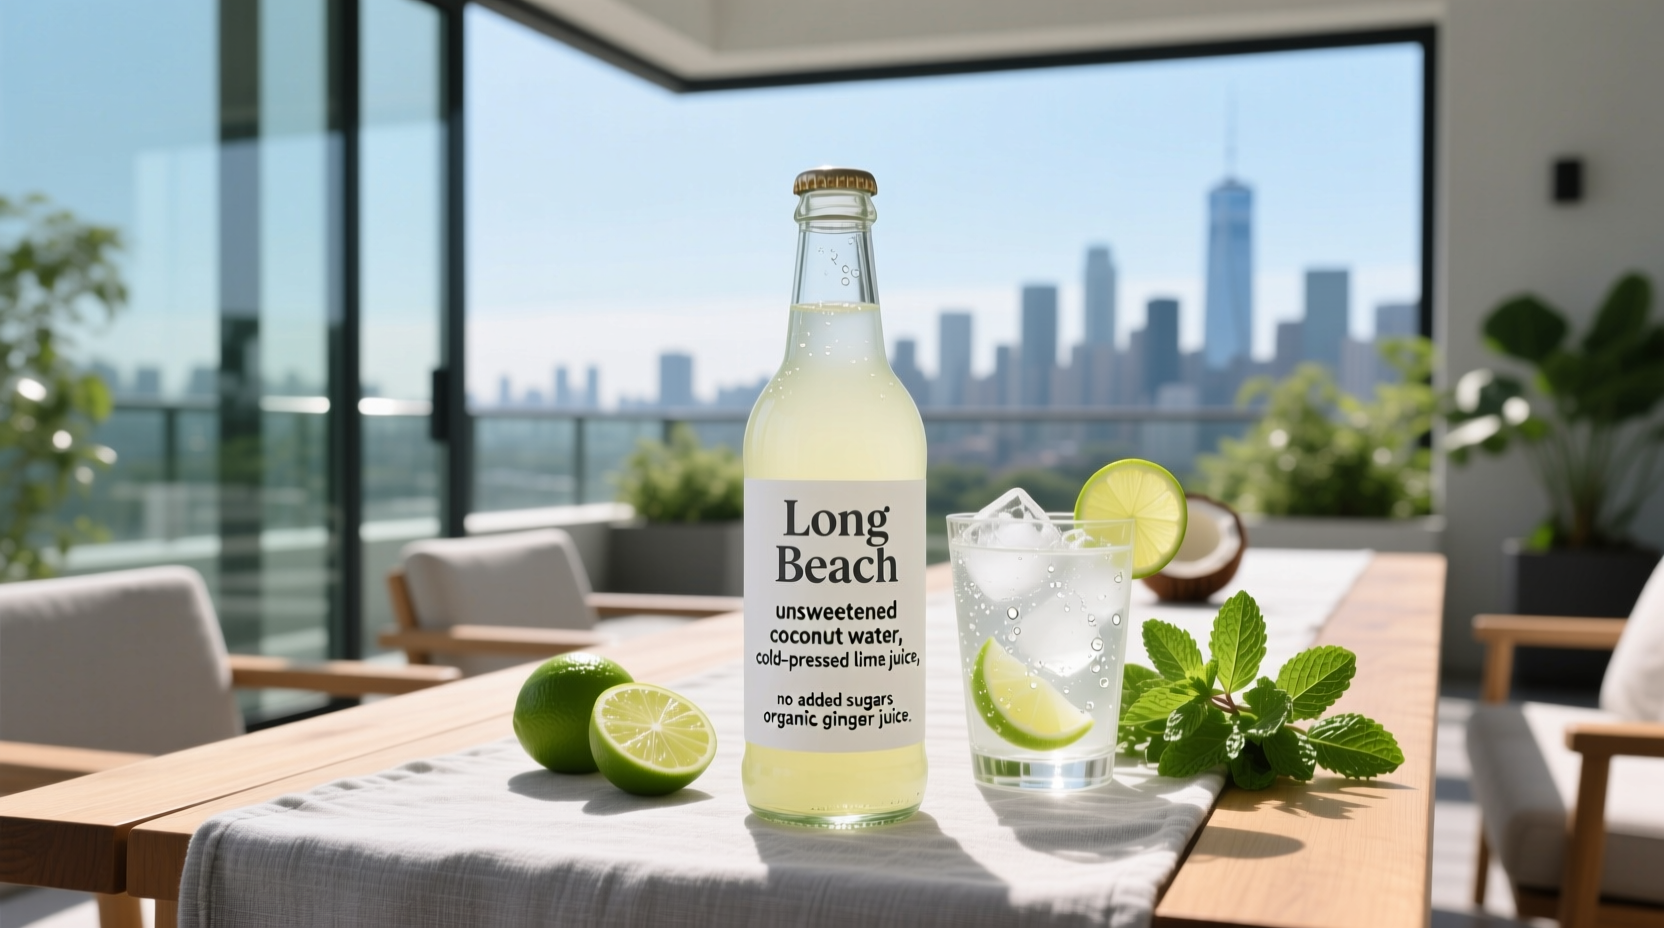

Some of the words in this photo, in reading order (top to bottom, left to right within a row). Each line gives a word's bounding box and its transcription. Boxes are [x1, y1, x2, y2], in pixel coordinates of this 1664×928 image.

[783, 499, 890, 547] Long
[775, 545, 899, 584] Beach
[775, 600, 897, 620] unsweetened
[769, 628, 844, 646] coconut
[847, 628, 903, 646] water,
[756, 649, 849, 672] cold-pressed
[854, 650, 886, 668] lime
[888, 648, 920, 671] juice,
[777, 694, 794, 706] no
[797, 692, 842, 707] added
[846, 694, 894, 711] sugars
[763, 709, 818, 729] organic
[822, 710, 875, 731] ginger
[878, 708, 912, 729] juice.
